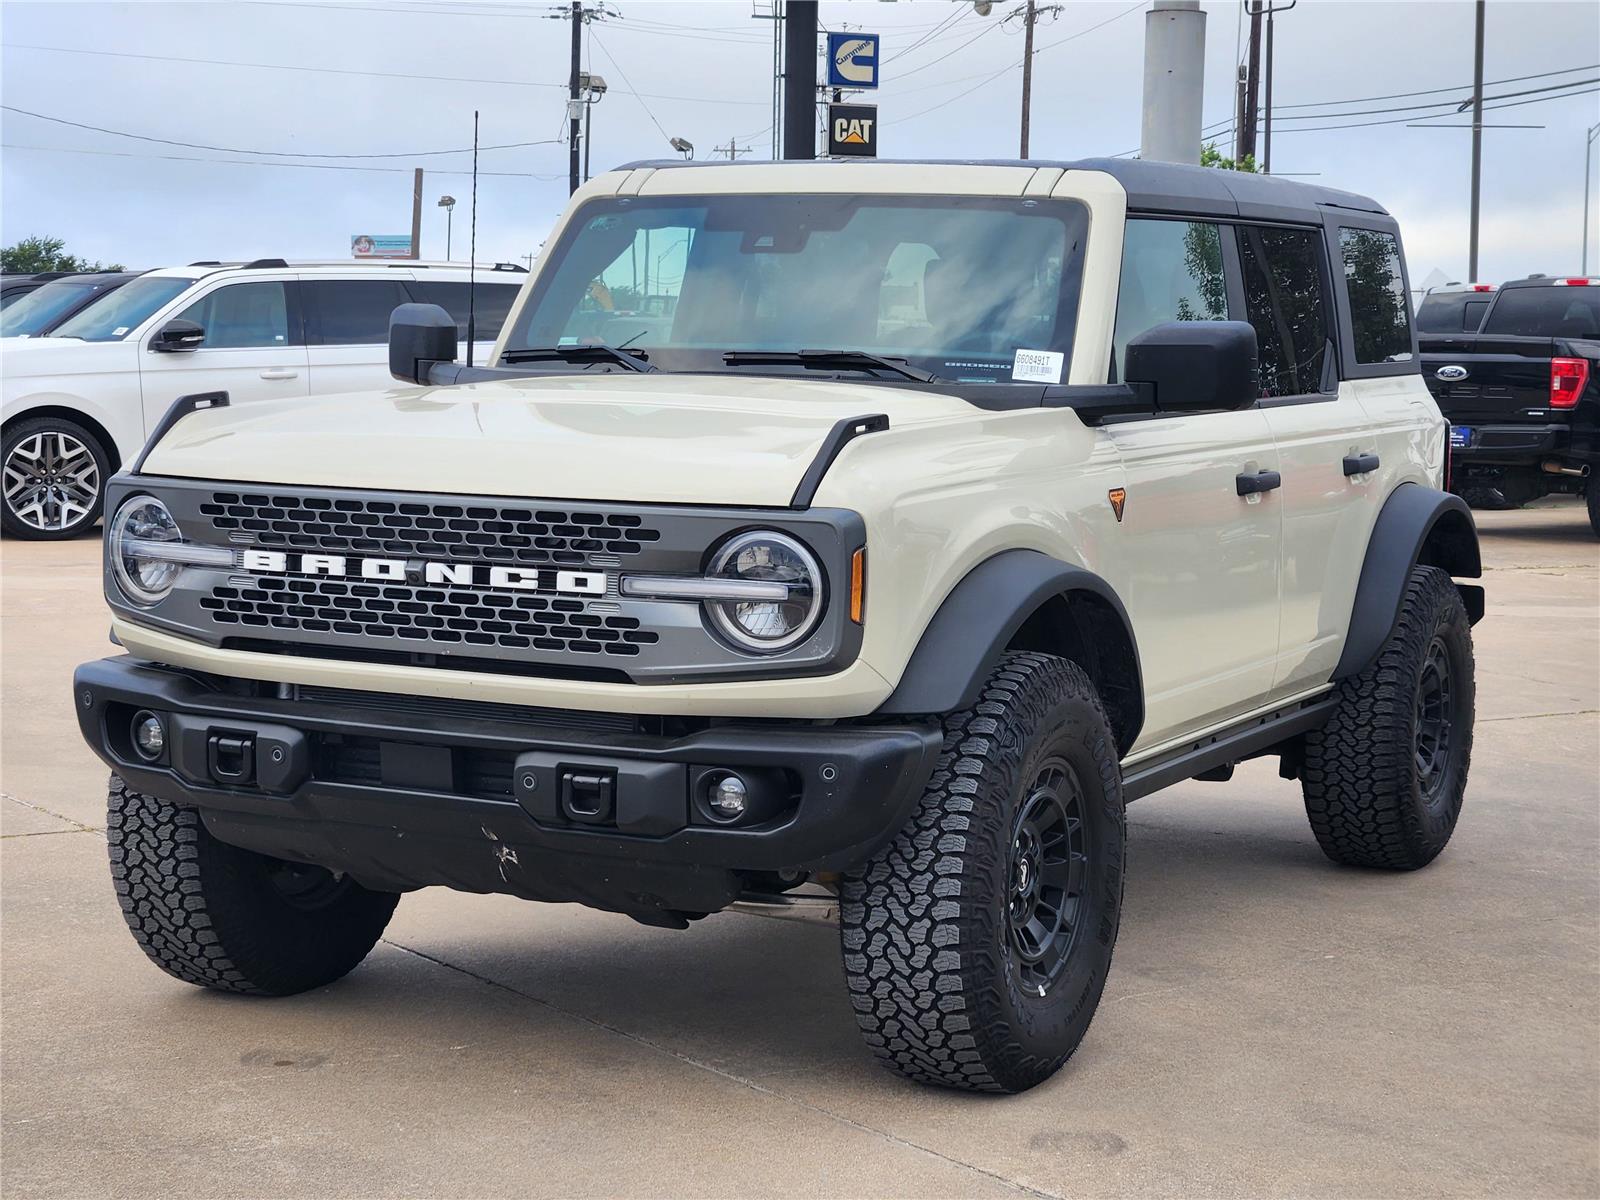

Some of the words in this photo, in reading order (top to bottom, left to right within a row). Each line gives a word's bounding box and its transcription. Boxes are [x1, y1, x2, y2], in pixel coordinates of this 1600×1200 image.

[835, 39, 872, 65] Cummins
[834, 118, 872, 144] CAT
[1016, 353, 1051, 366] 6608491T
[243, 549, 607, 594] BRONCO
